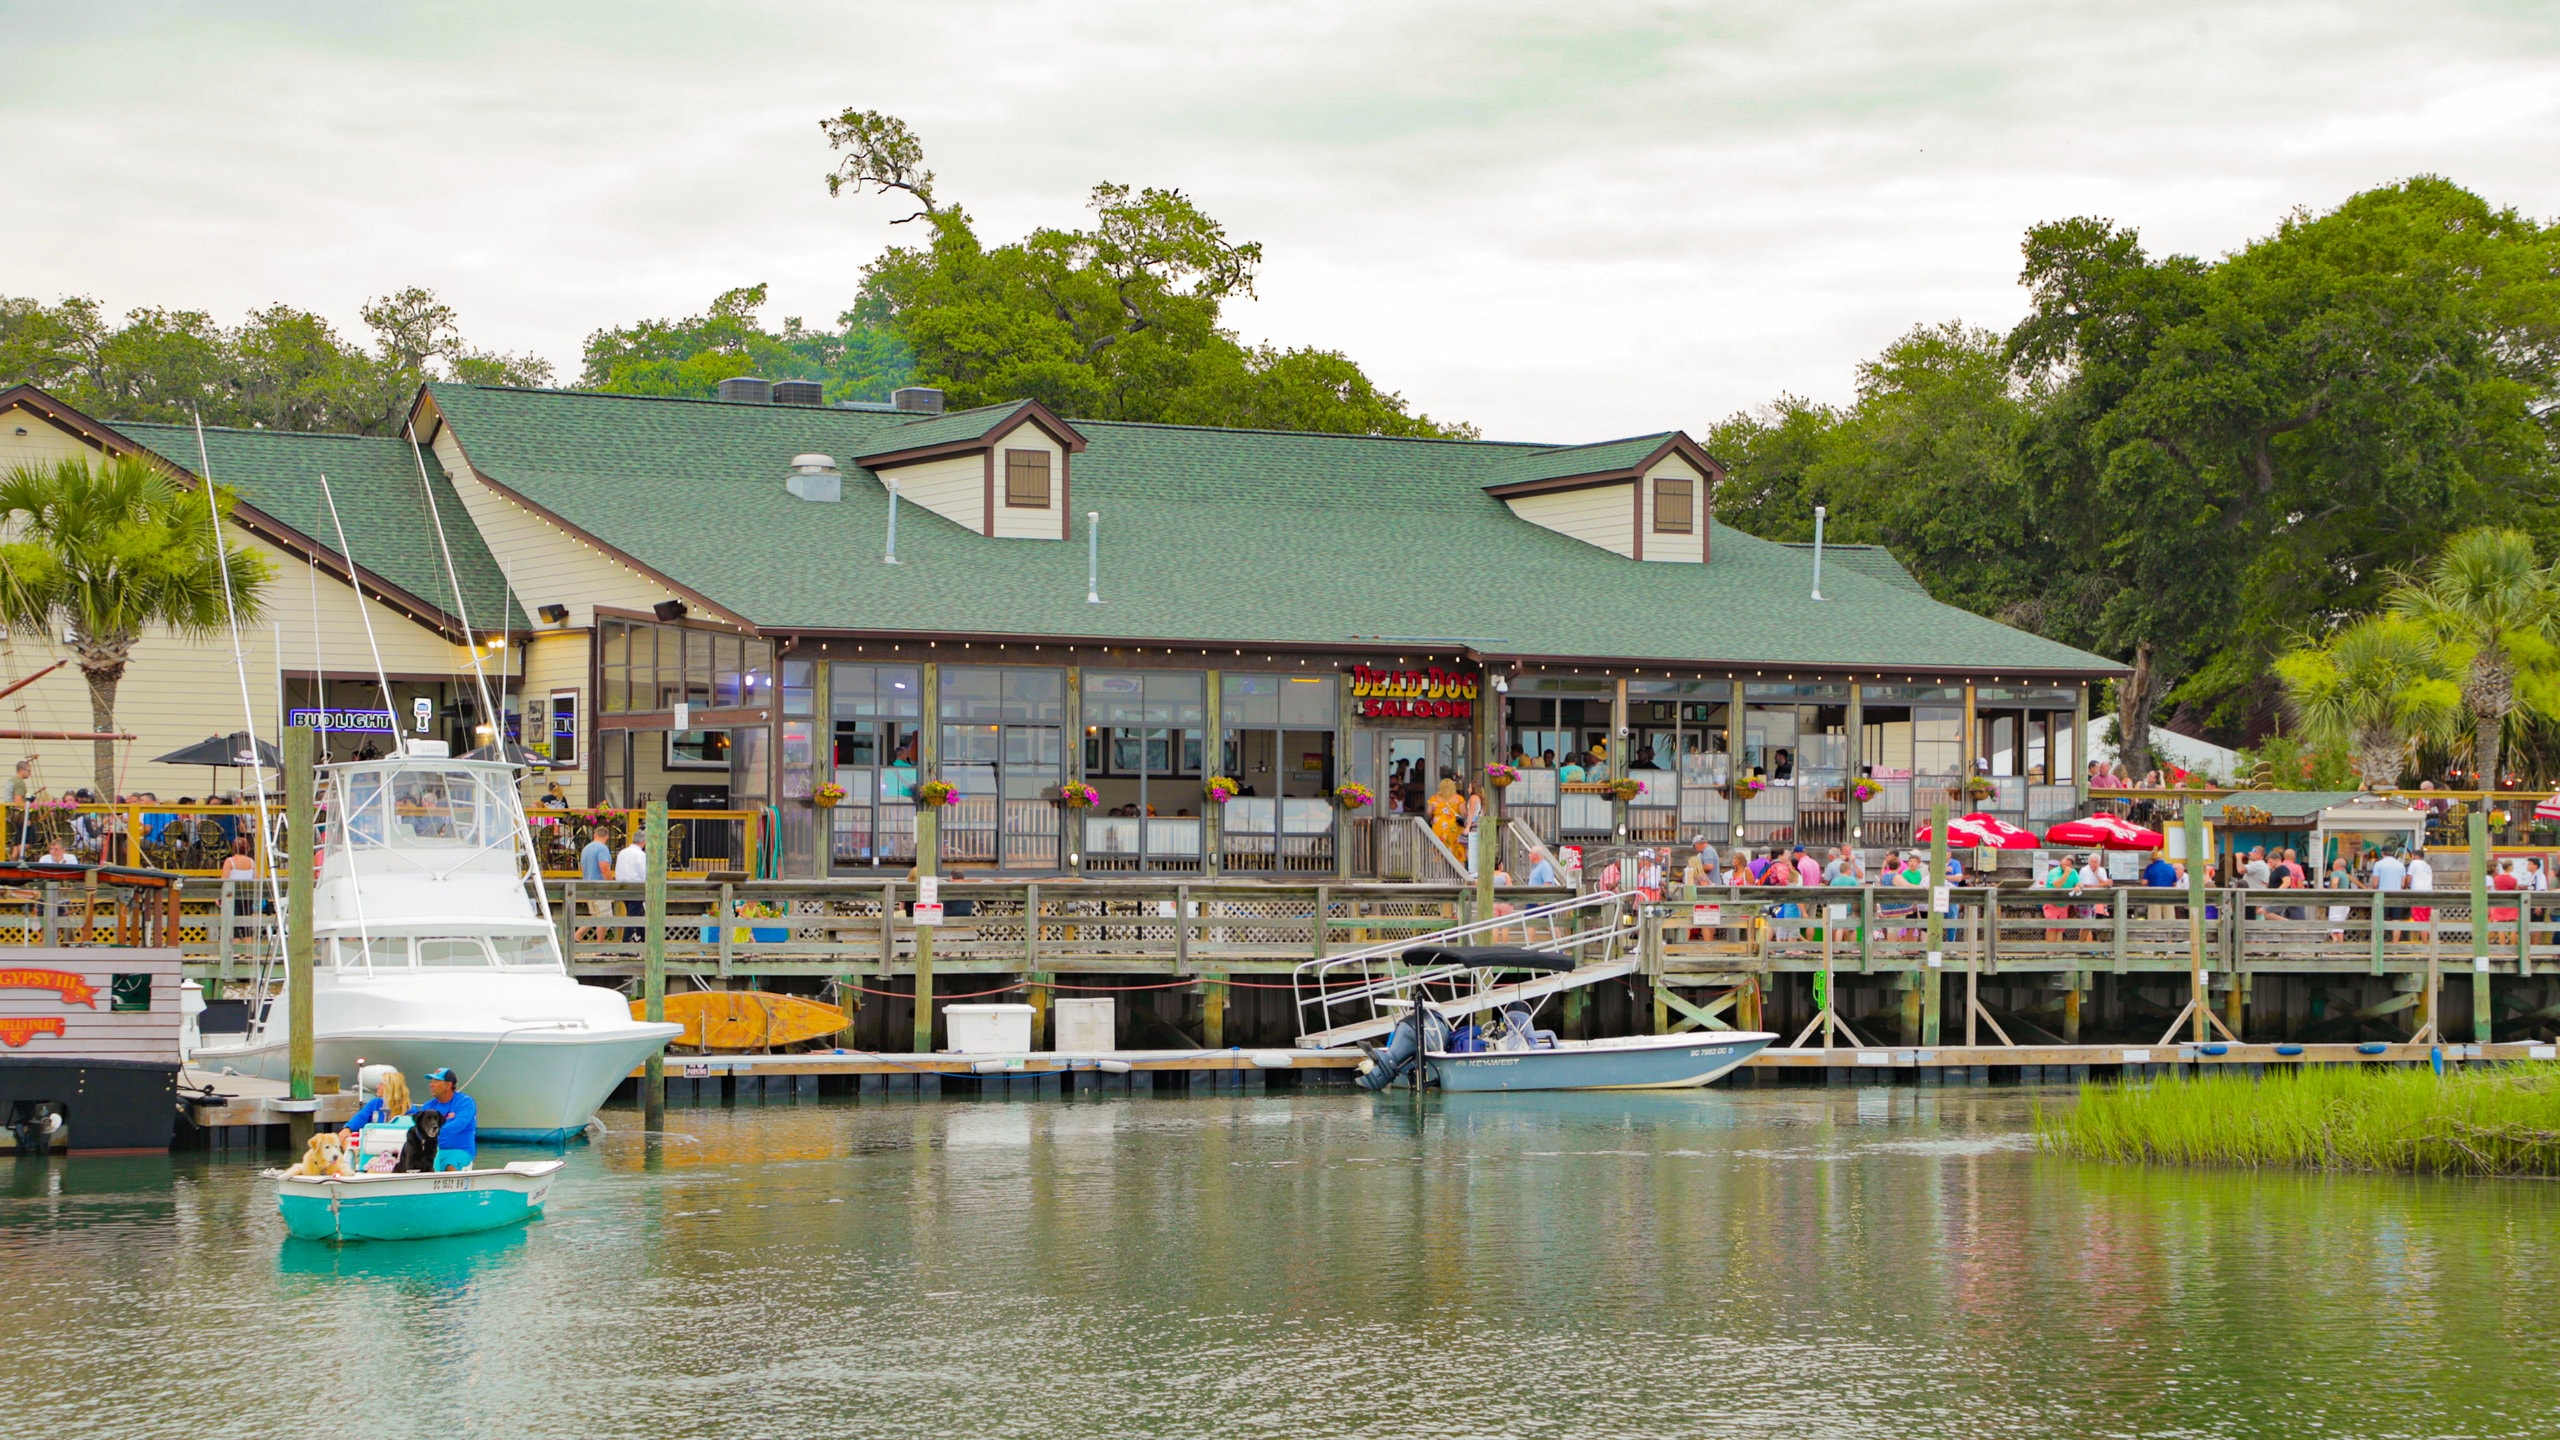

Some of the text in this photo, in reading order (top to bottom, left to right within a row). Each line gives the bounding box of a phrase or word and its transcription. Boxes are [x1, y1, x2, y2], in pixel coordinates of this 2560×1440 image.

[1353, 664, 1478, 699] DEAD DOG
[1364, 699, 1471, 718] SALOON
[294, 713, 392, 729] BUD LIGHT
[0, 971, 77, 989] GYPSY III
[29, 1019, 56, 1031] INLET
[10, 1031, 23, 1042] SC
[1491, 1058, 1520, 1066] WEST
